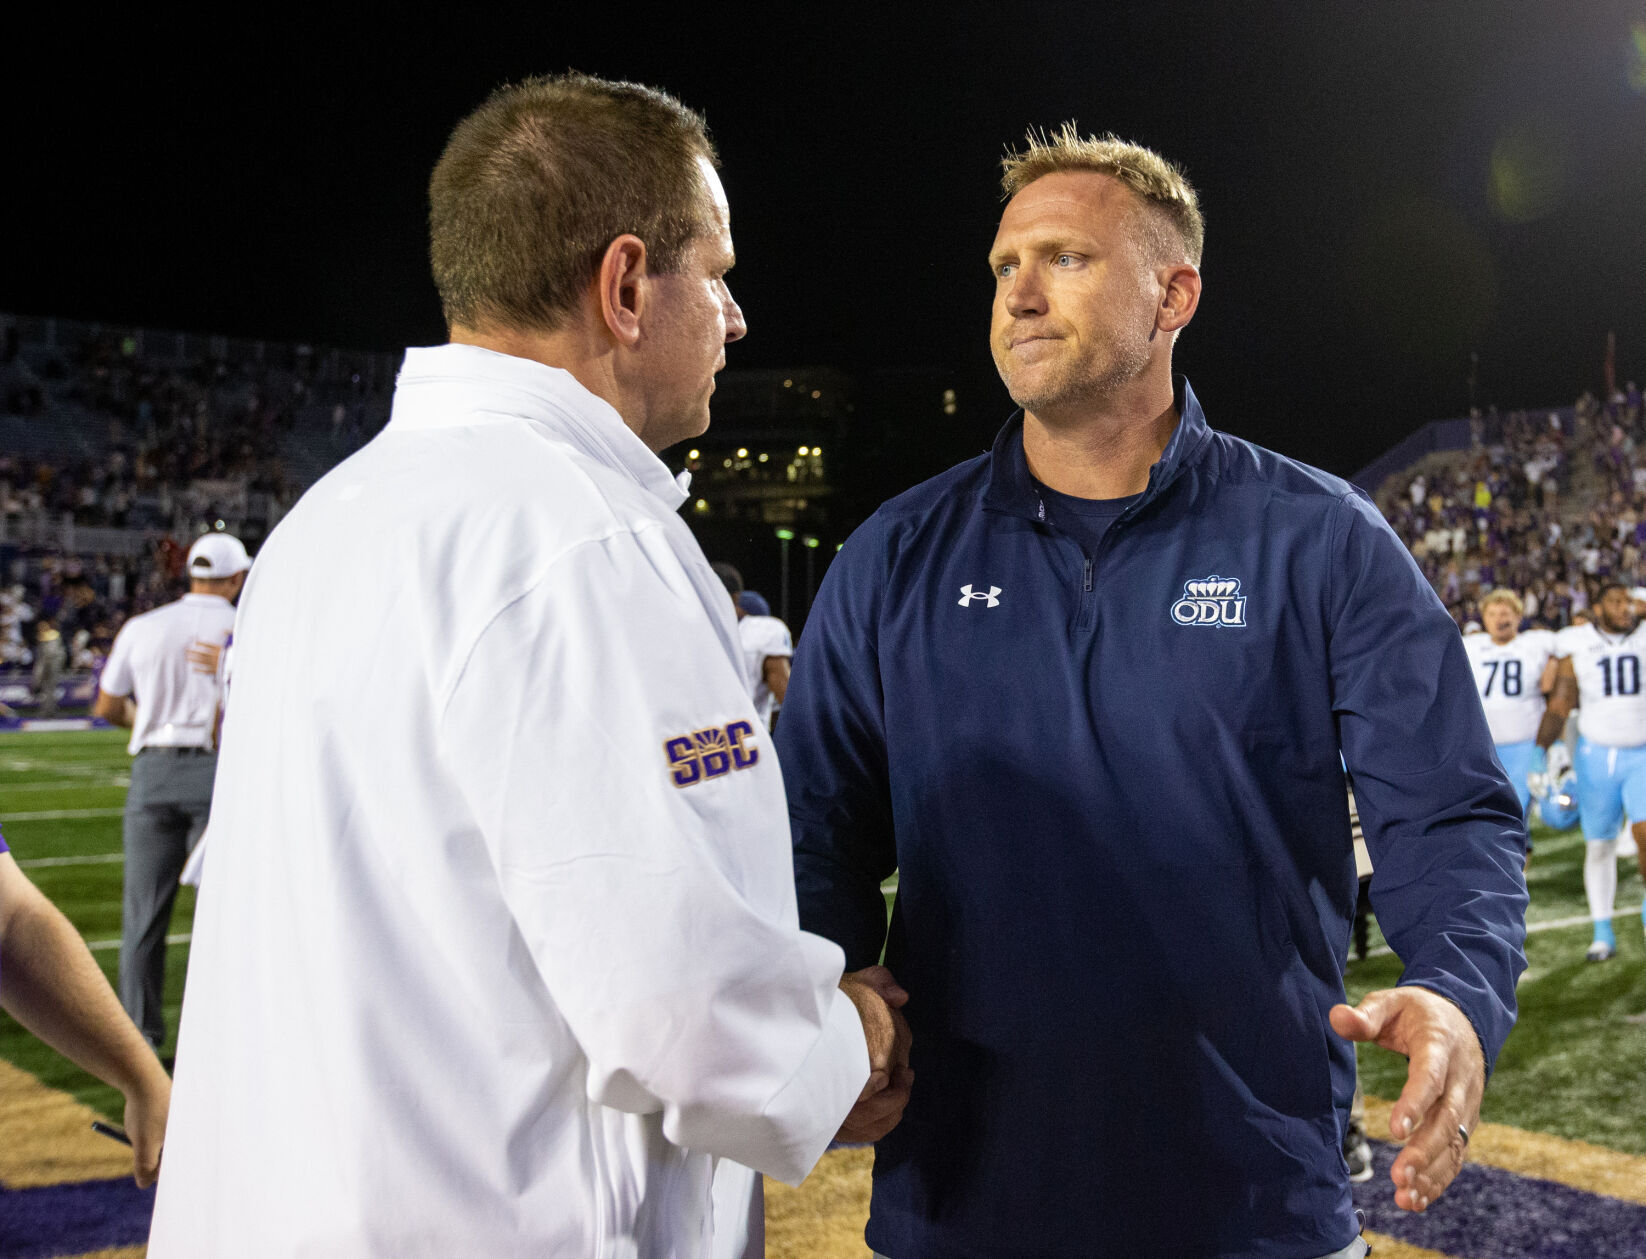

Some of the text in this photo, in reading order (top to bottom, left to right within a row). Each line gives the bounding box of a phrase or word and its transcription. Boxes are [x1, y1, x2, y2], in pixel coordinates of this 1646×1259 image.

[1172, 599, 1245, 626] ODU
[1483, 659, 1522, 697] 78
[1597, 655, 1640, 697] 10
[663, 719, 759, 788] SBC
